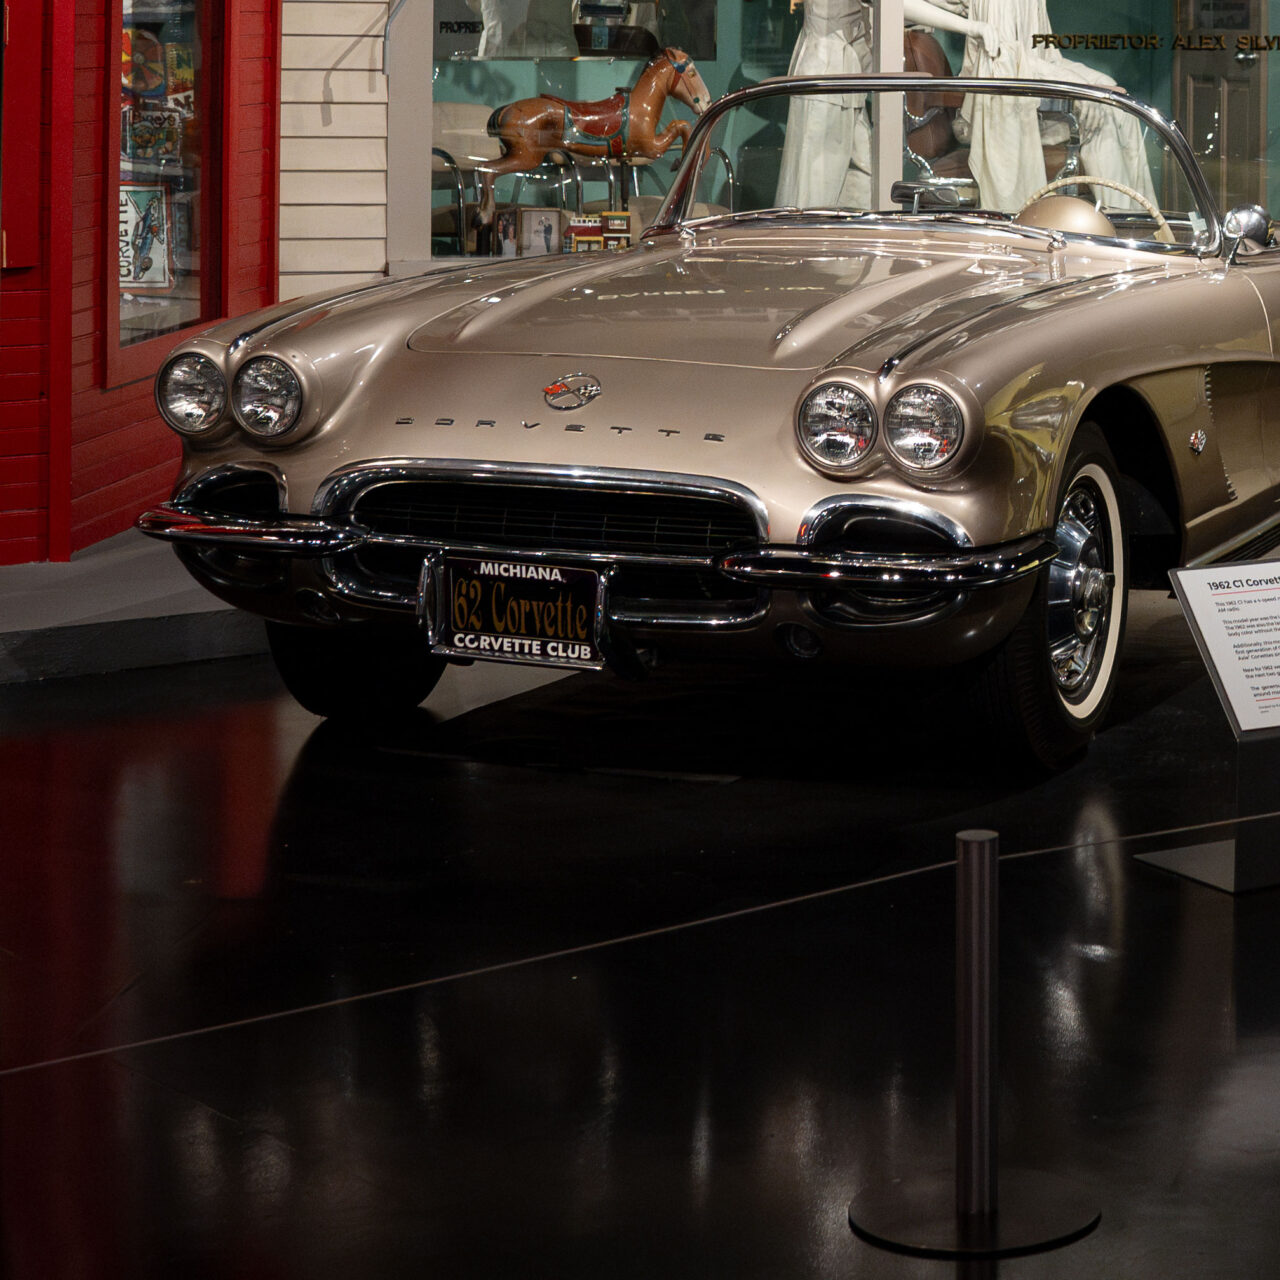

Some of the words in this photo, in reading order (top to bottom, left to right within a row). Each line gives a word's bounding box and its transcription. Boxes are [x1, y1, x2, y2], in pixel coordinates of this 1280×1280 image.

[1171, 33, 1227, 51] ALEX
[395, 417, 726, 442] CORVETTE
[479, 562, 562, 582] MICHIANA
[1207, 580, 1232, 591] 1962
[1232, 580, 1244, 588] C1
[453, 577, 483, 631] 62
[491, 582, 588, 640] Corvette
[453, 633, 541, 655] CORVETTE
[547, 642, 592, 660] CLUB
